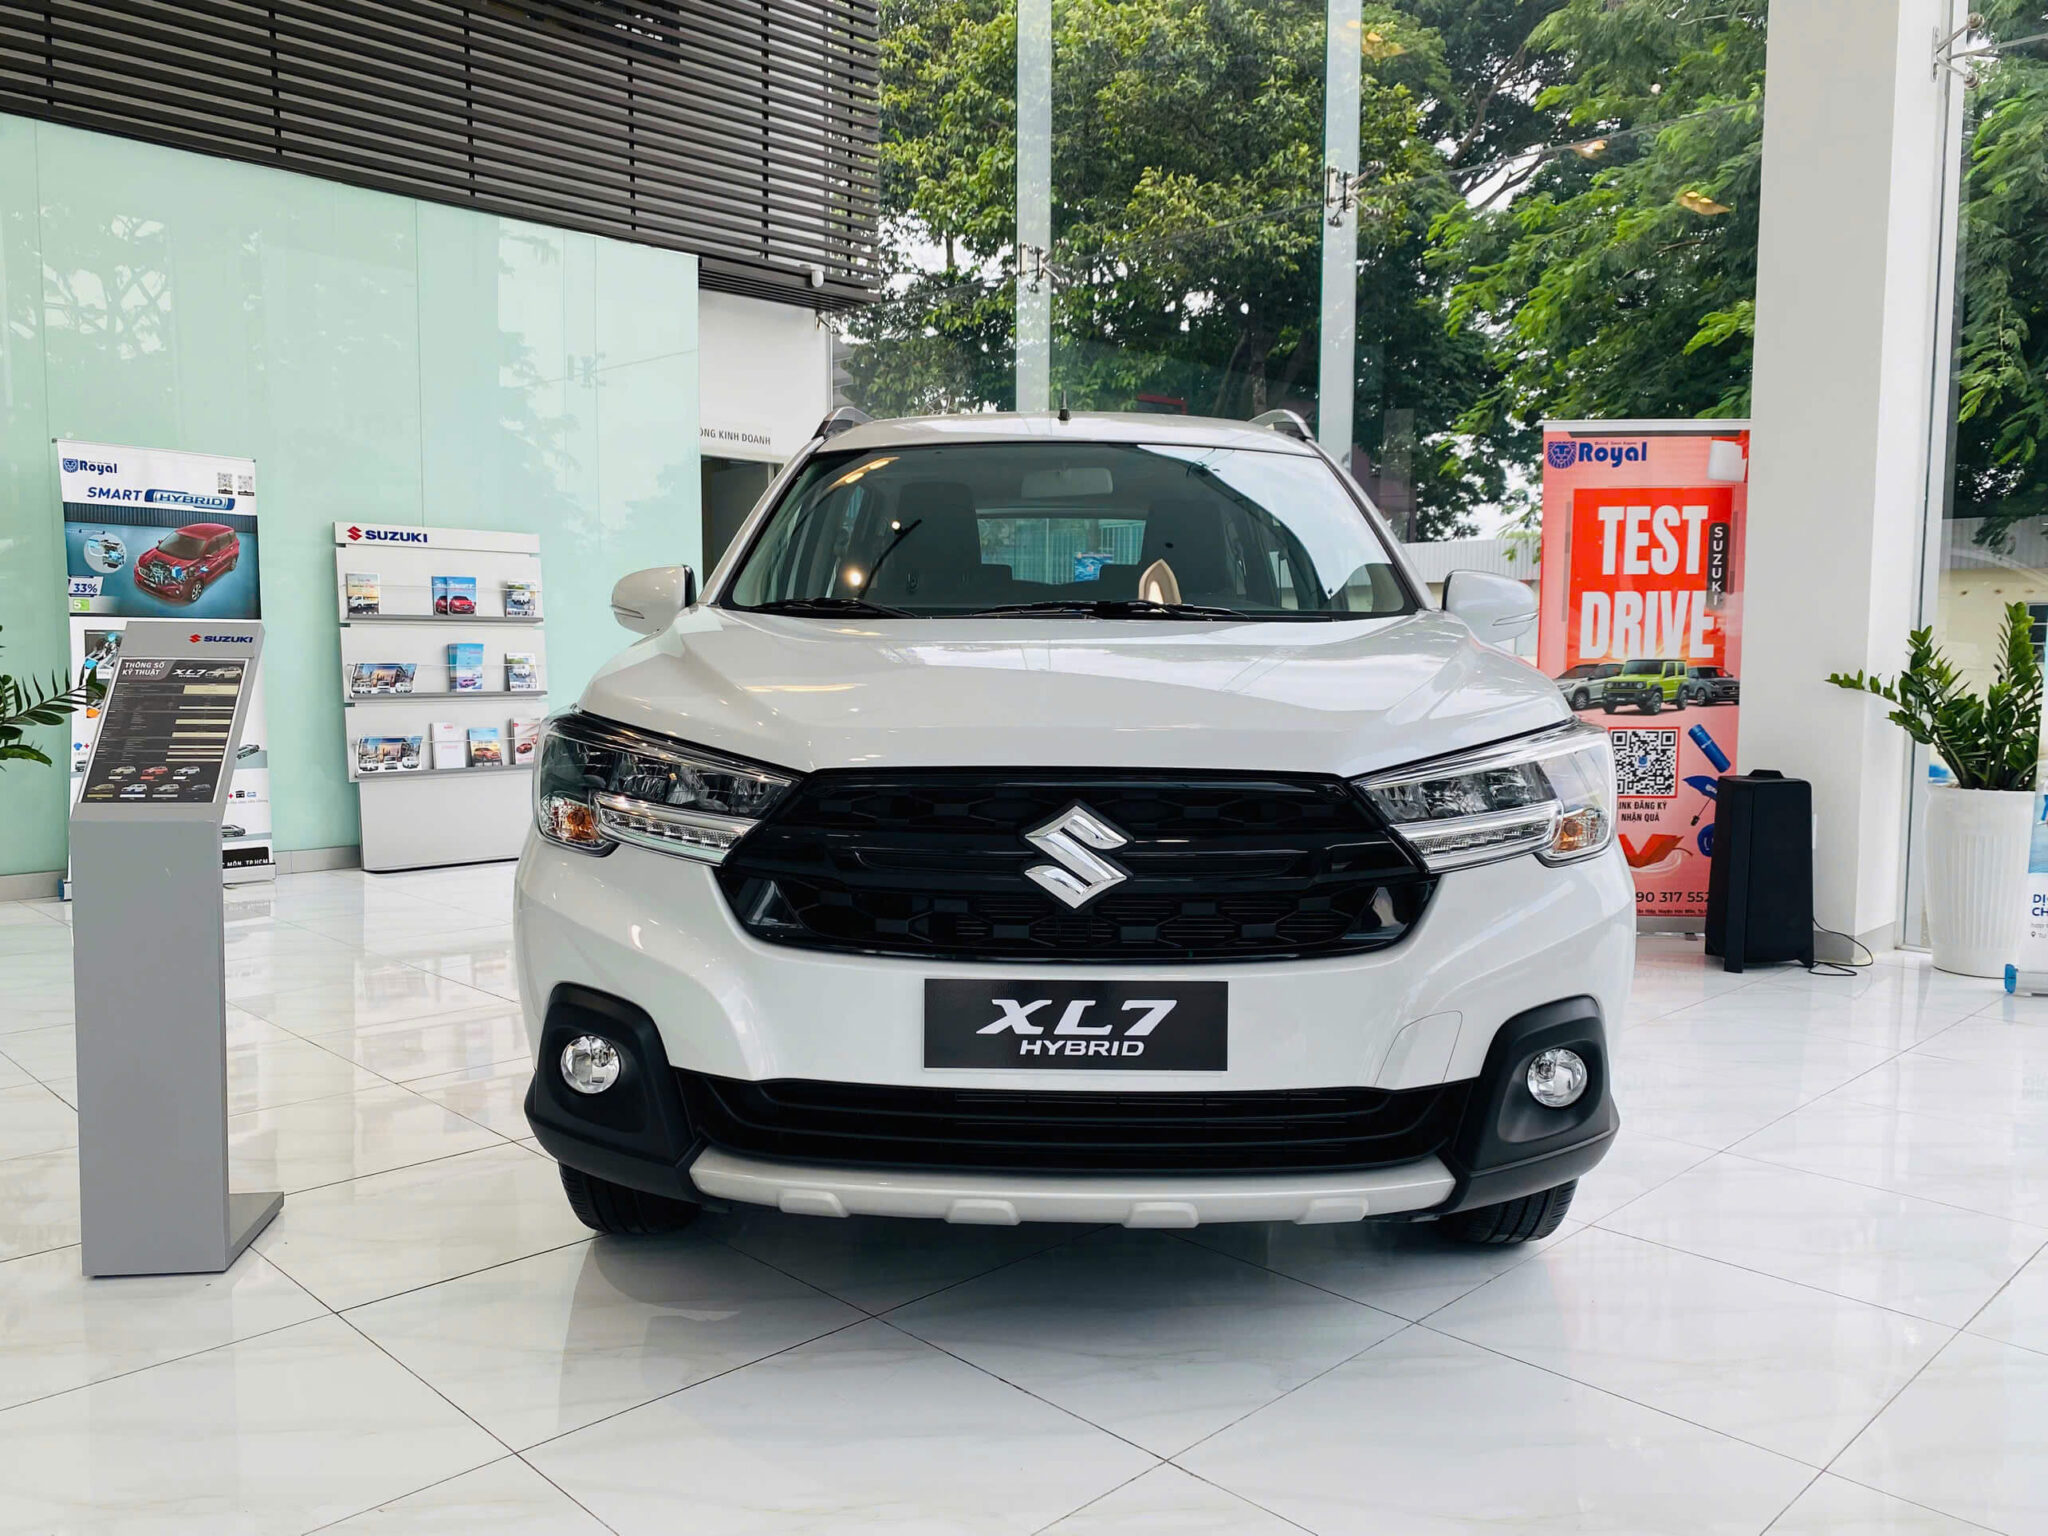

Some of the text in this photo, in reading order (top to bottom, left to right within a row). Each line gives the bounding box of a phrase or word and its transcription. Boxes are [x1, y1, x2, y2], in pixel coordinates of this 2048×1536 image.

[718, 429, 739, 441] KINH
[741, 433, 771, 445] DOANH
[1578, 441, 1647, 468] Royal
[79, 460, 117, 475] Royal
[87, 487, 223, 506] SMART HYBRID
[365, 529, 428, 543] SUZUKI
[1598, 505, 1709, 576] TEST
[1711, 526, 1724, 606] SUZUKI
[73, 583, 98, 593] 33%
[1579, 590, 1715, 659] DRIVE
[203, 635, 253, 643] SUZUKI
[125, 661, 152, 669] THÔNG
[135, 669, 161, 677] THUẬT
[1634, 800, 1655, 810] ĐĂNG
[1621, 812, 1642, 823] NHẬN
[1659, 891, 1683, 903] 317
[2033, 894, 2048, 906] DỊ
[976, 999, 1177, 1036] XL7
[1019, 1039, 1145, 1056] HYBRID
